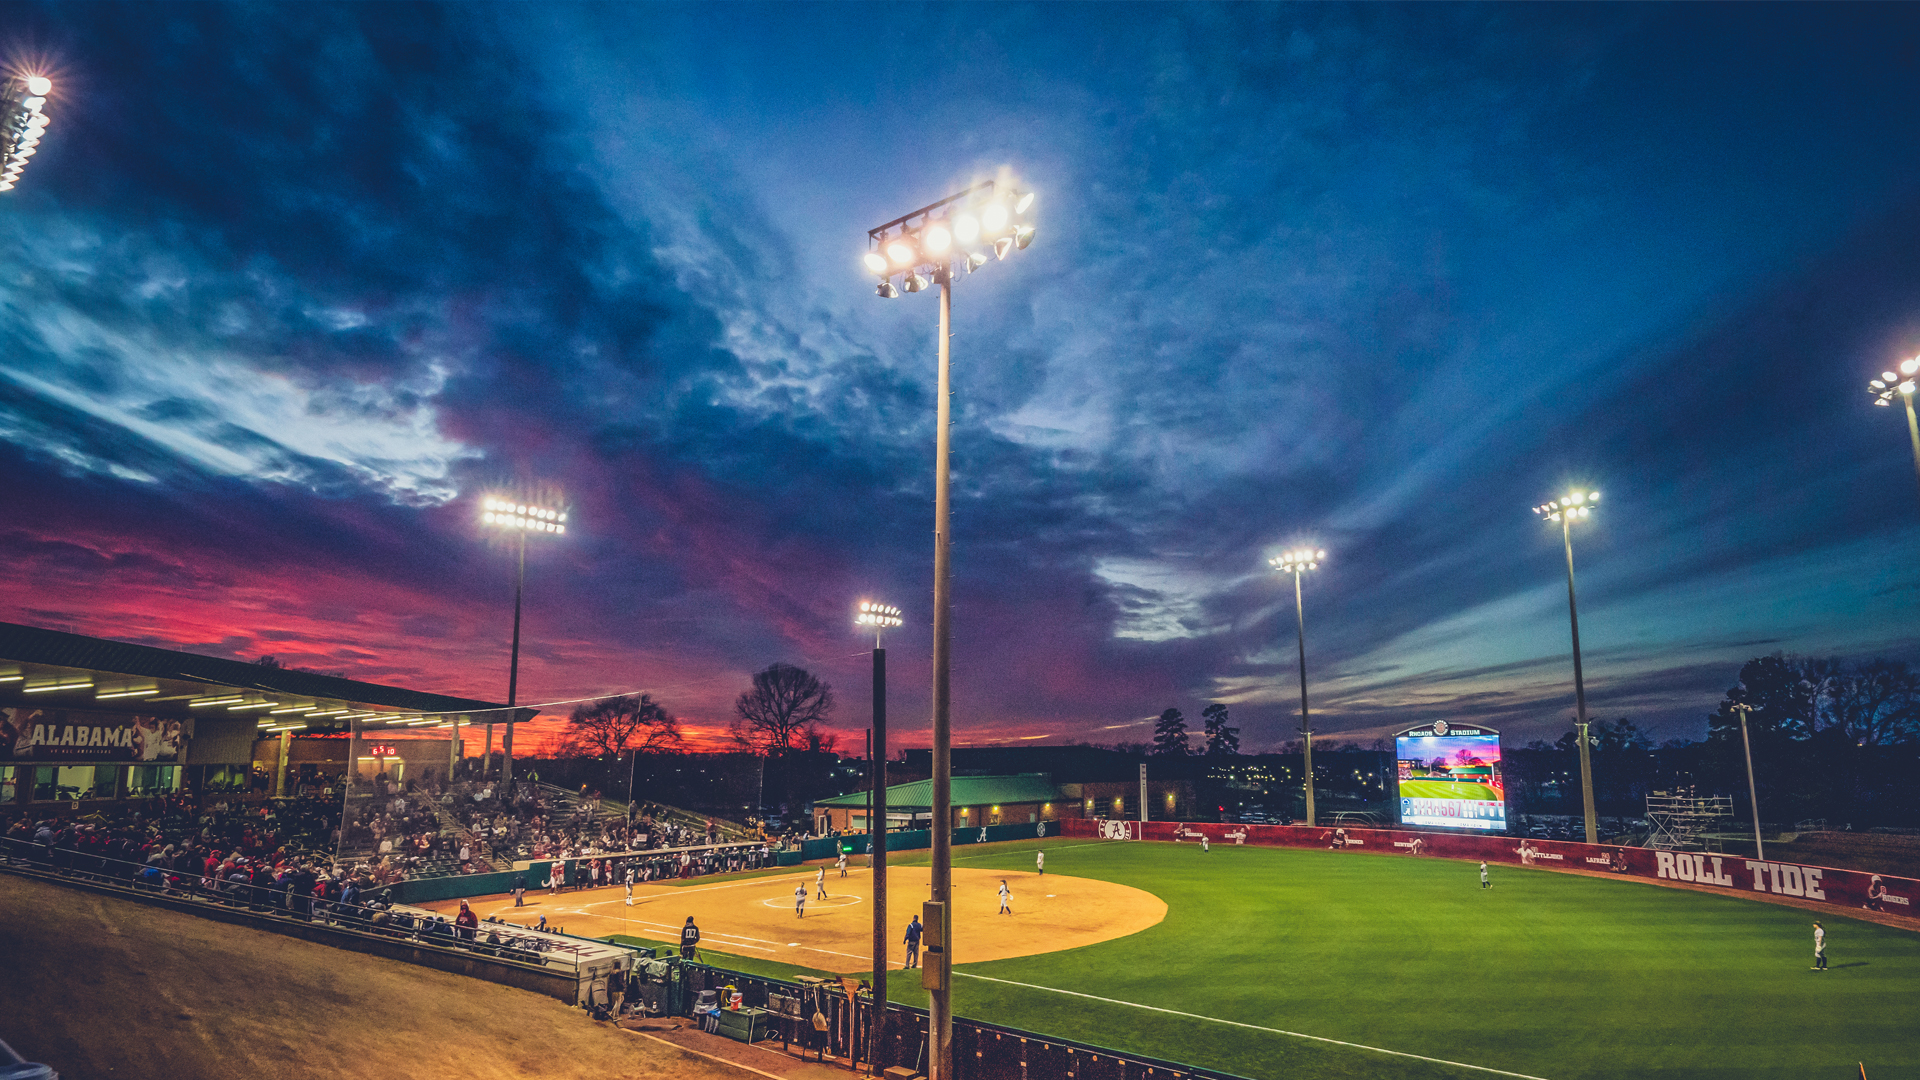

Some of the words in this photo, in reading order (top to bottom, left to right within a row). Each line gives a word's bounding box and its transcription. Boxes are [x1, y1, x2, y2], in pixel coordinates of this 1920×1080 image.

[30, 724, 133, 747] ALABAMA
[1655, 851, 1733, 887] ROLL
[1745, 860, 1826, 900] TIDE
